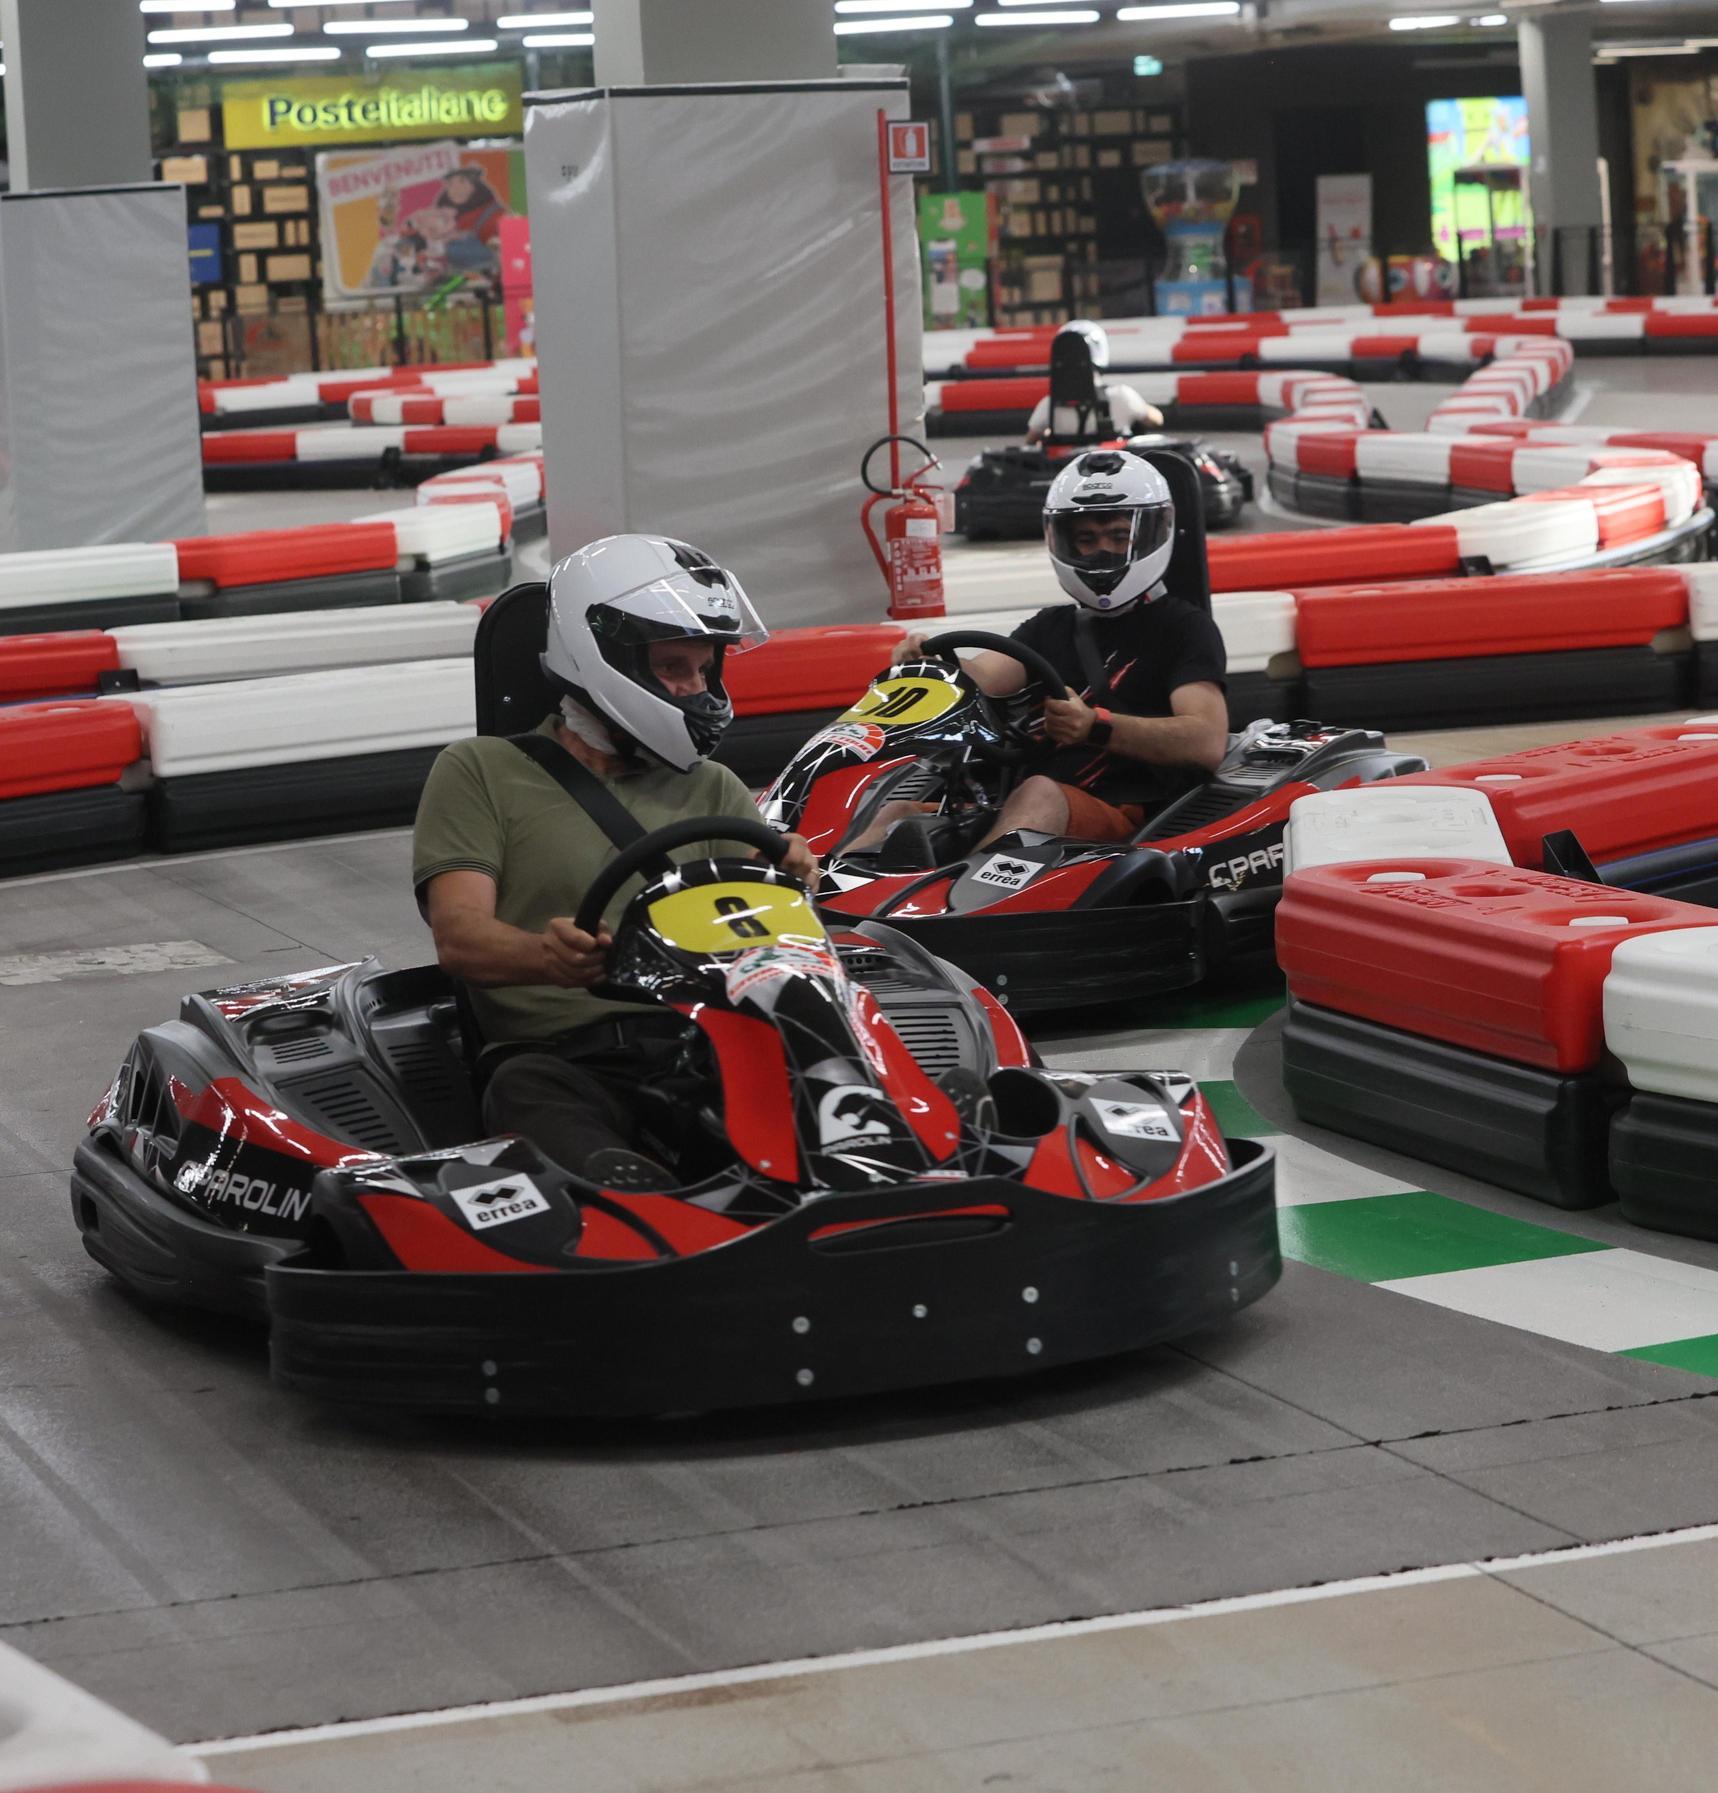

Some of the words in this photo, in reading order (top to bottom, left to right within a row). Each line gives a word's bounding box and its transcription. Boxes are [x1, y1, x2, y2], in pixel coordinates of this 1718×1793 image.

[860, 686, 928, 718] 10
[980, 871, 1021, 886] errea
[476, 1199, 538, 1222] errea
